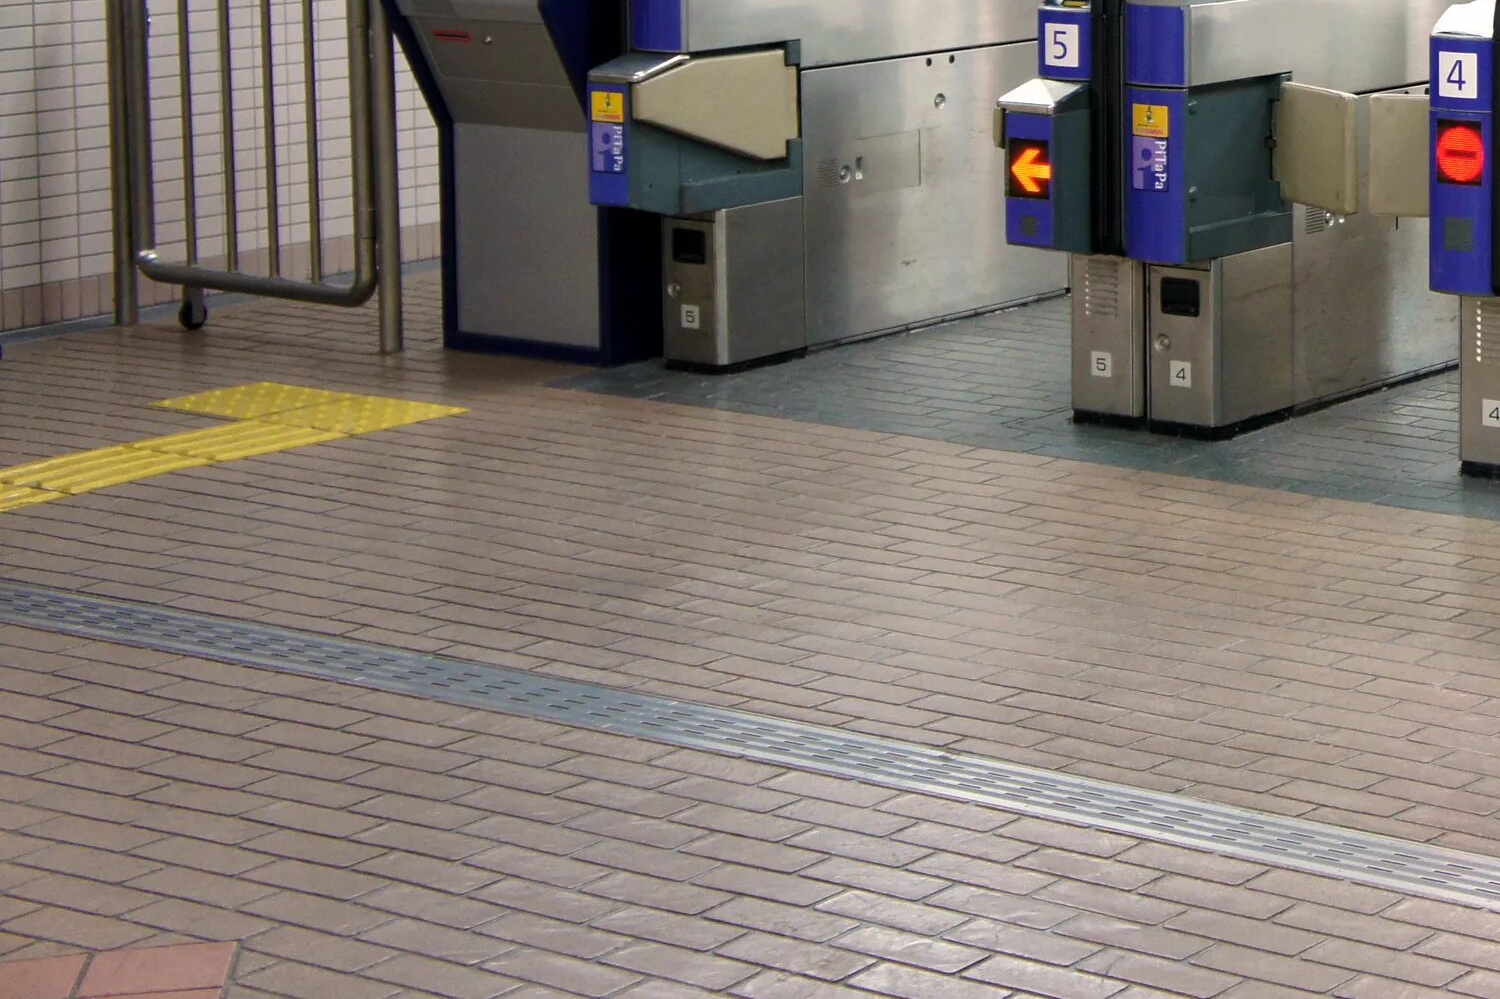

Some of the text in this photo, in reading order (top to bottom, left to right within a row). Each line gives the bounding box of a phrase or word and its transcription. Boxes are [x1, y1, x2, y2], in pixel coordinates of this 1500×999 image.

[1053, 31, 1067, 60] 5
[1446, 60, 1467, 91] 4
[613, 126, 623, 171] PiTaPa
[1155, 141, 1167, 189] PiTaPa
[685, 311, 694, 324] 5
[1096, 357, 1107, 371] 5
[1175, 367, 1186, 382] 4
[1488, 406, 1500, 420] 4
